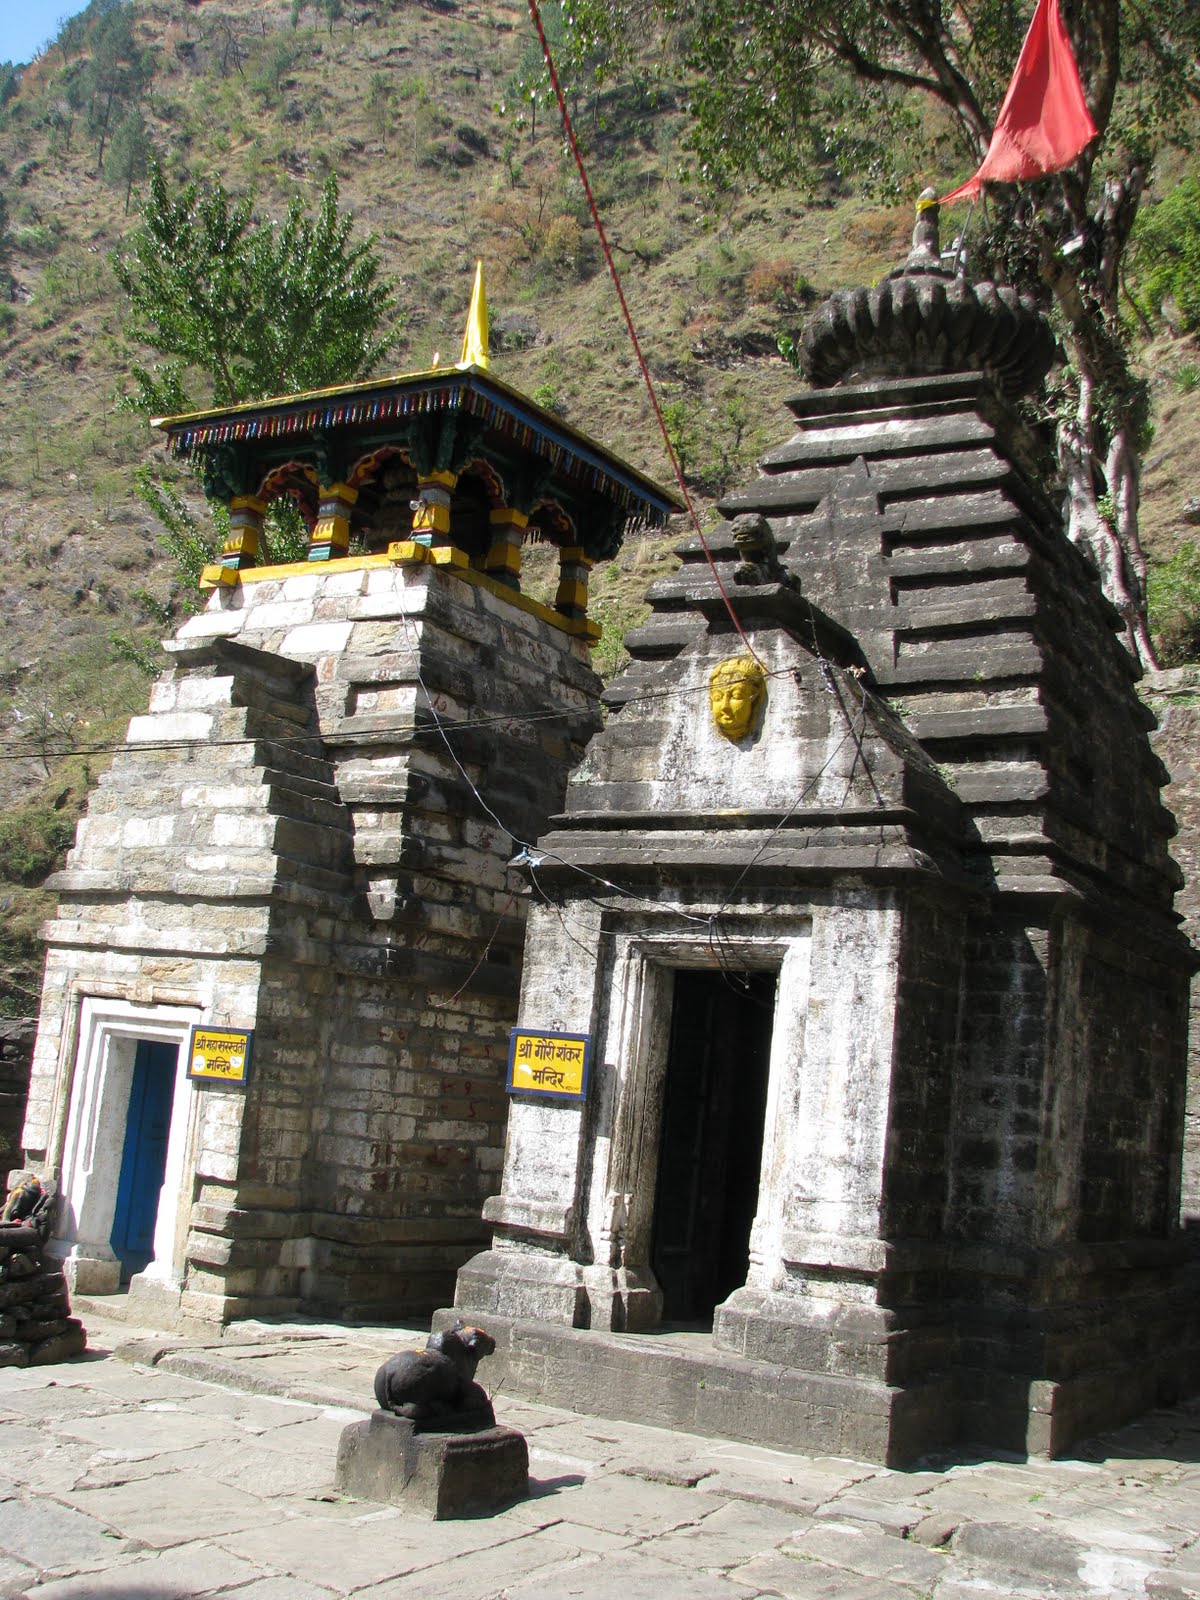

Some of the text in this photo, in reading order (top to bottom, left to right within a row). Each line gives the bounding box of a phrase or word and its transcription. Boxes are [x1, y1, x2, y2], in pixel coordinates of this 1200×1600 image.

[195, 1035, 206, 1050] श्री
[518, 1039, 532, 1058] श्री
[534, 1038, 555, 1061] गौरी
[556, 1043, 582, 1064] शंकर
[206, 1056, 231, 1075] मन्दिर
[532, 1067, 565, 1089] मन्दिर
